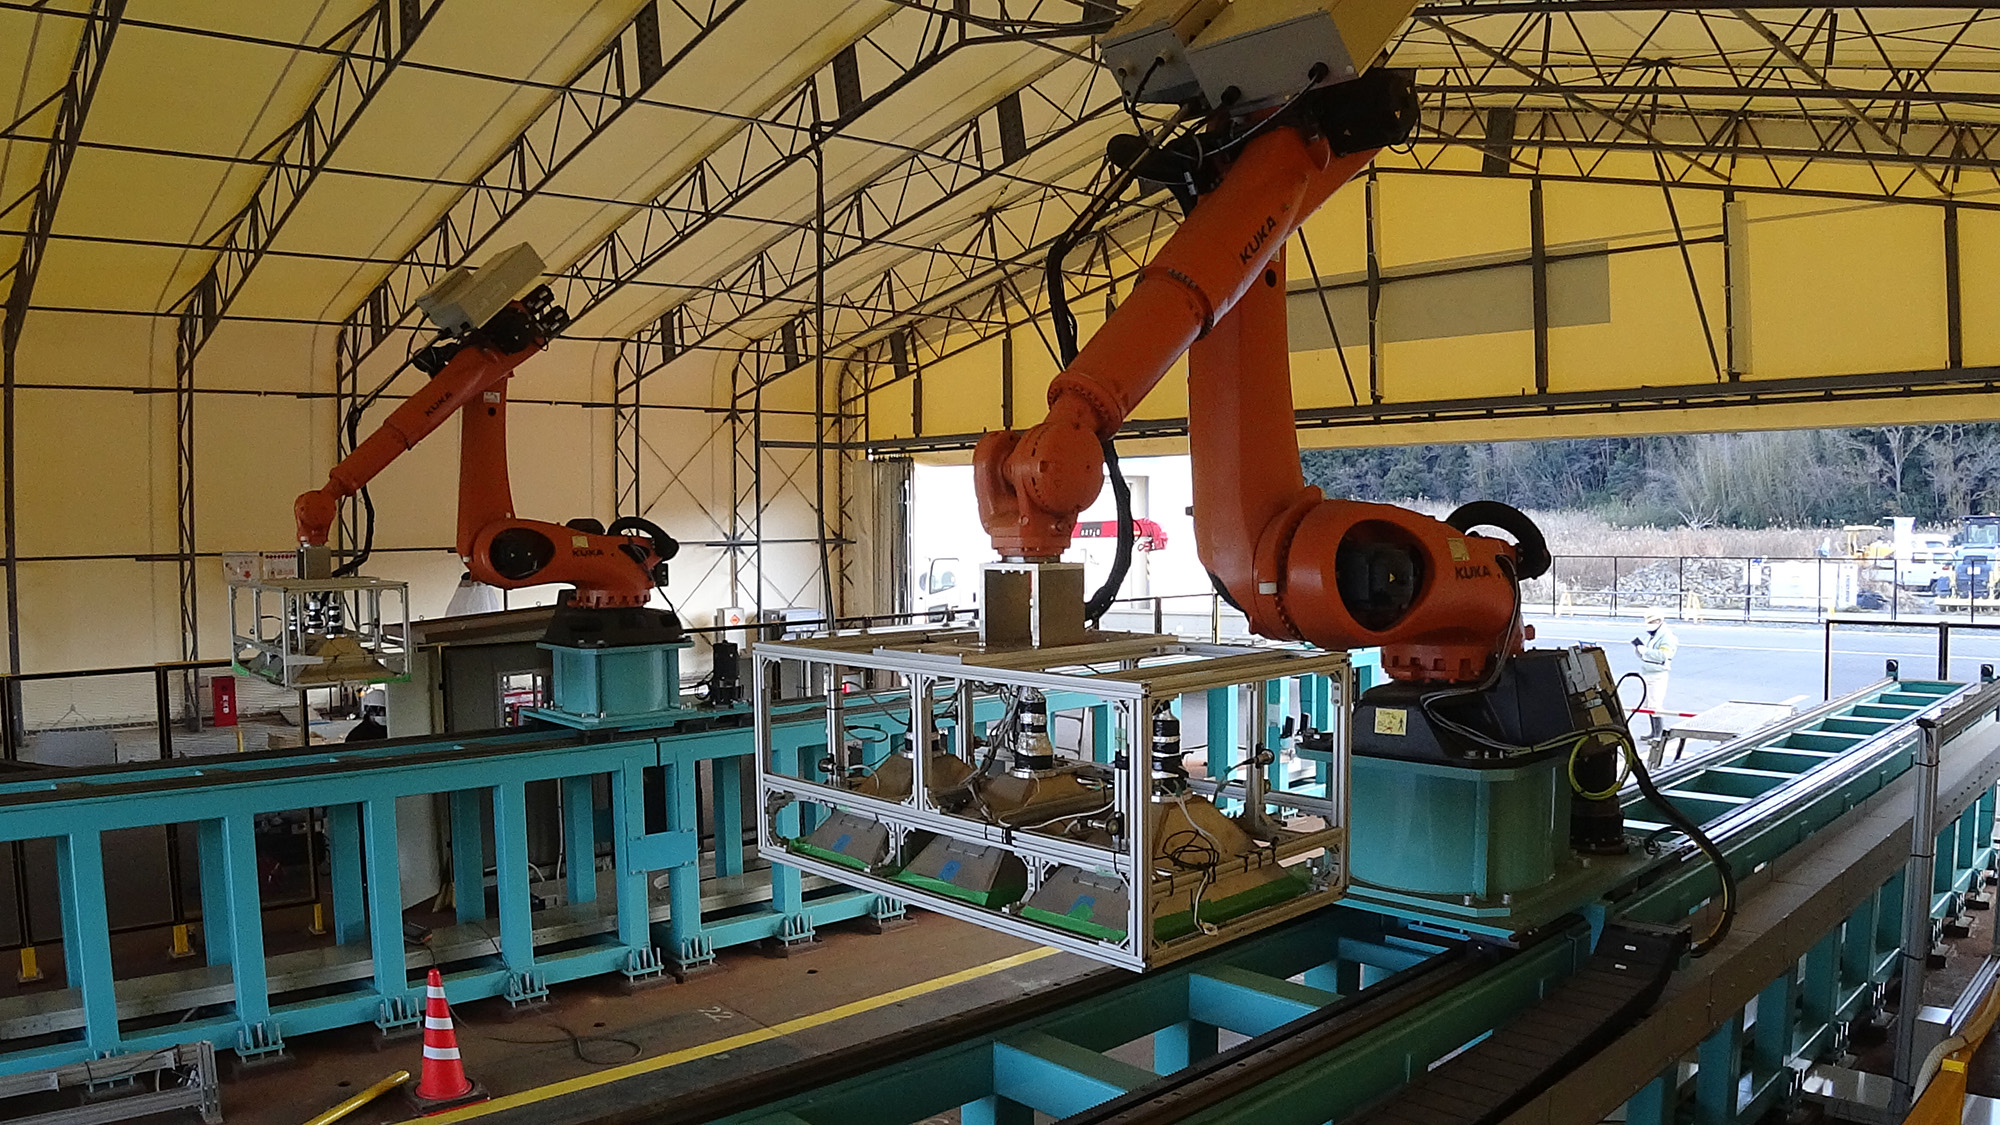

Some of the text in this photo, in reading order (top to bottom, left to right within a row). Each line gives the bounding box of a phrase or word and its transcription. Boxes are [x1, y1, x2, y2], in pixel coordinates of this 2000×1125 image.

[1239, 216, 1277, 265] KUKA
[424, 391, 453, 417] KUKA
[572, 548, 604, 557] KUKA
[1455, 566, 1490, 580] KUKA
